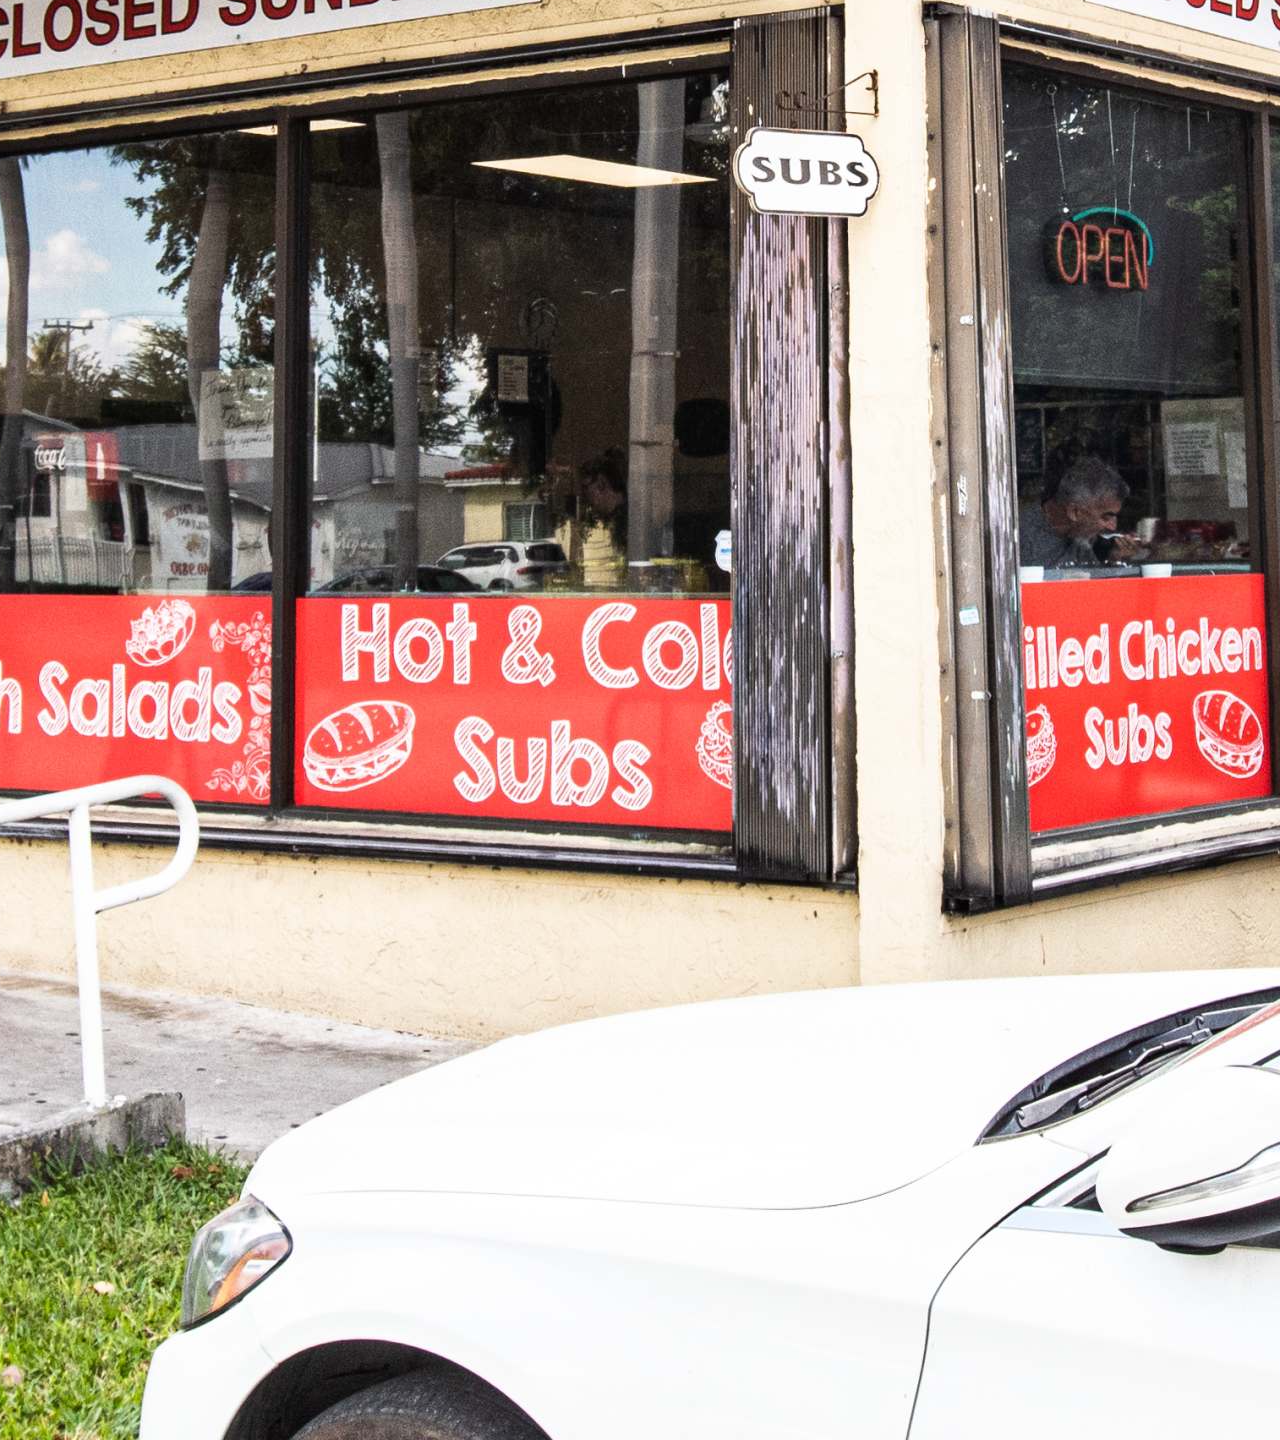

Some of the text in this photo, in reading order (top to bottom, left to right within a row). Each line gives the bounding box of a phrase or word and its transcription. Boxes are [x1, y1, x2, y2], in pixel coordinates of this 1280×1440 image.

[751, 156, 869, 187] SUBS
[1056, 221, 1148, 290] OPEN
[341, 602, 732, 691] Hot & Col
[1024, 617, 1263, 689] illed Chicken
[37, 660, 243, 745] Salads
[1084, 703, 1172, 769] Subs
[453, 715, 653, 811] Subs
